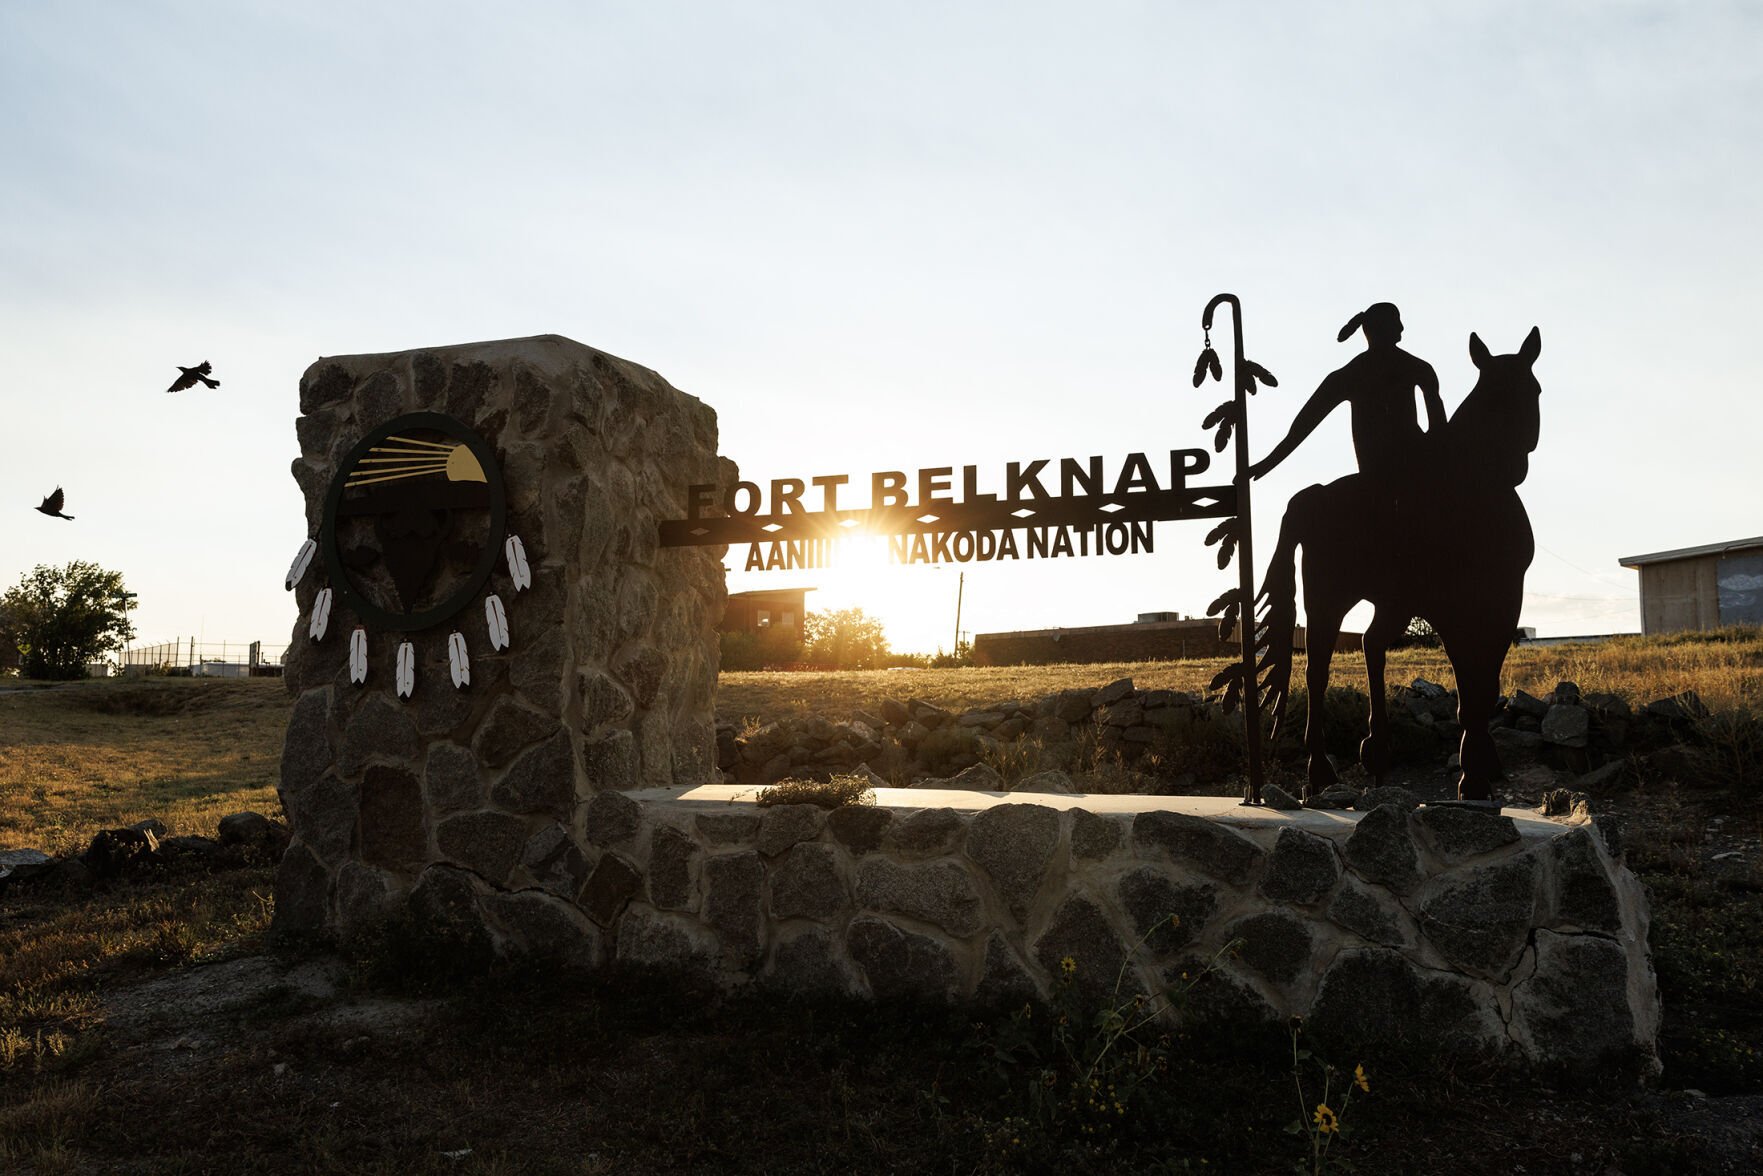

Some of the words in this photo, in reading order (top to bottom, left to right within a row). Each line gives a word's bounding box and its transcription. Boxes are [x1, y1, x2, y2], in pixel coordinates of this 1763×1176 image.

[688, 475, 848, 519] FORT
[871, 448, 1211, 509] BELKNAP
[889, 526, 1018, 565] NAKODA
[1027, 520, 1154, 558] NATION
